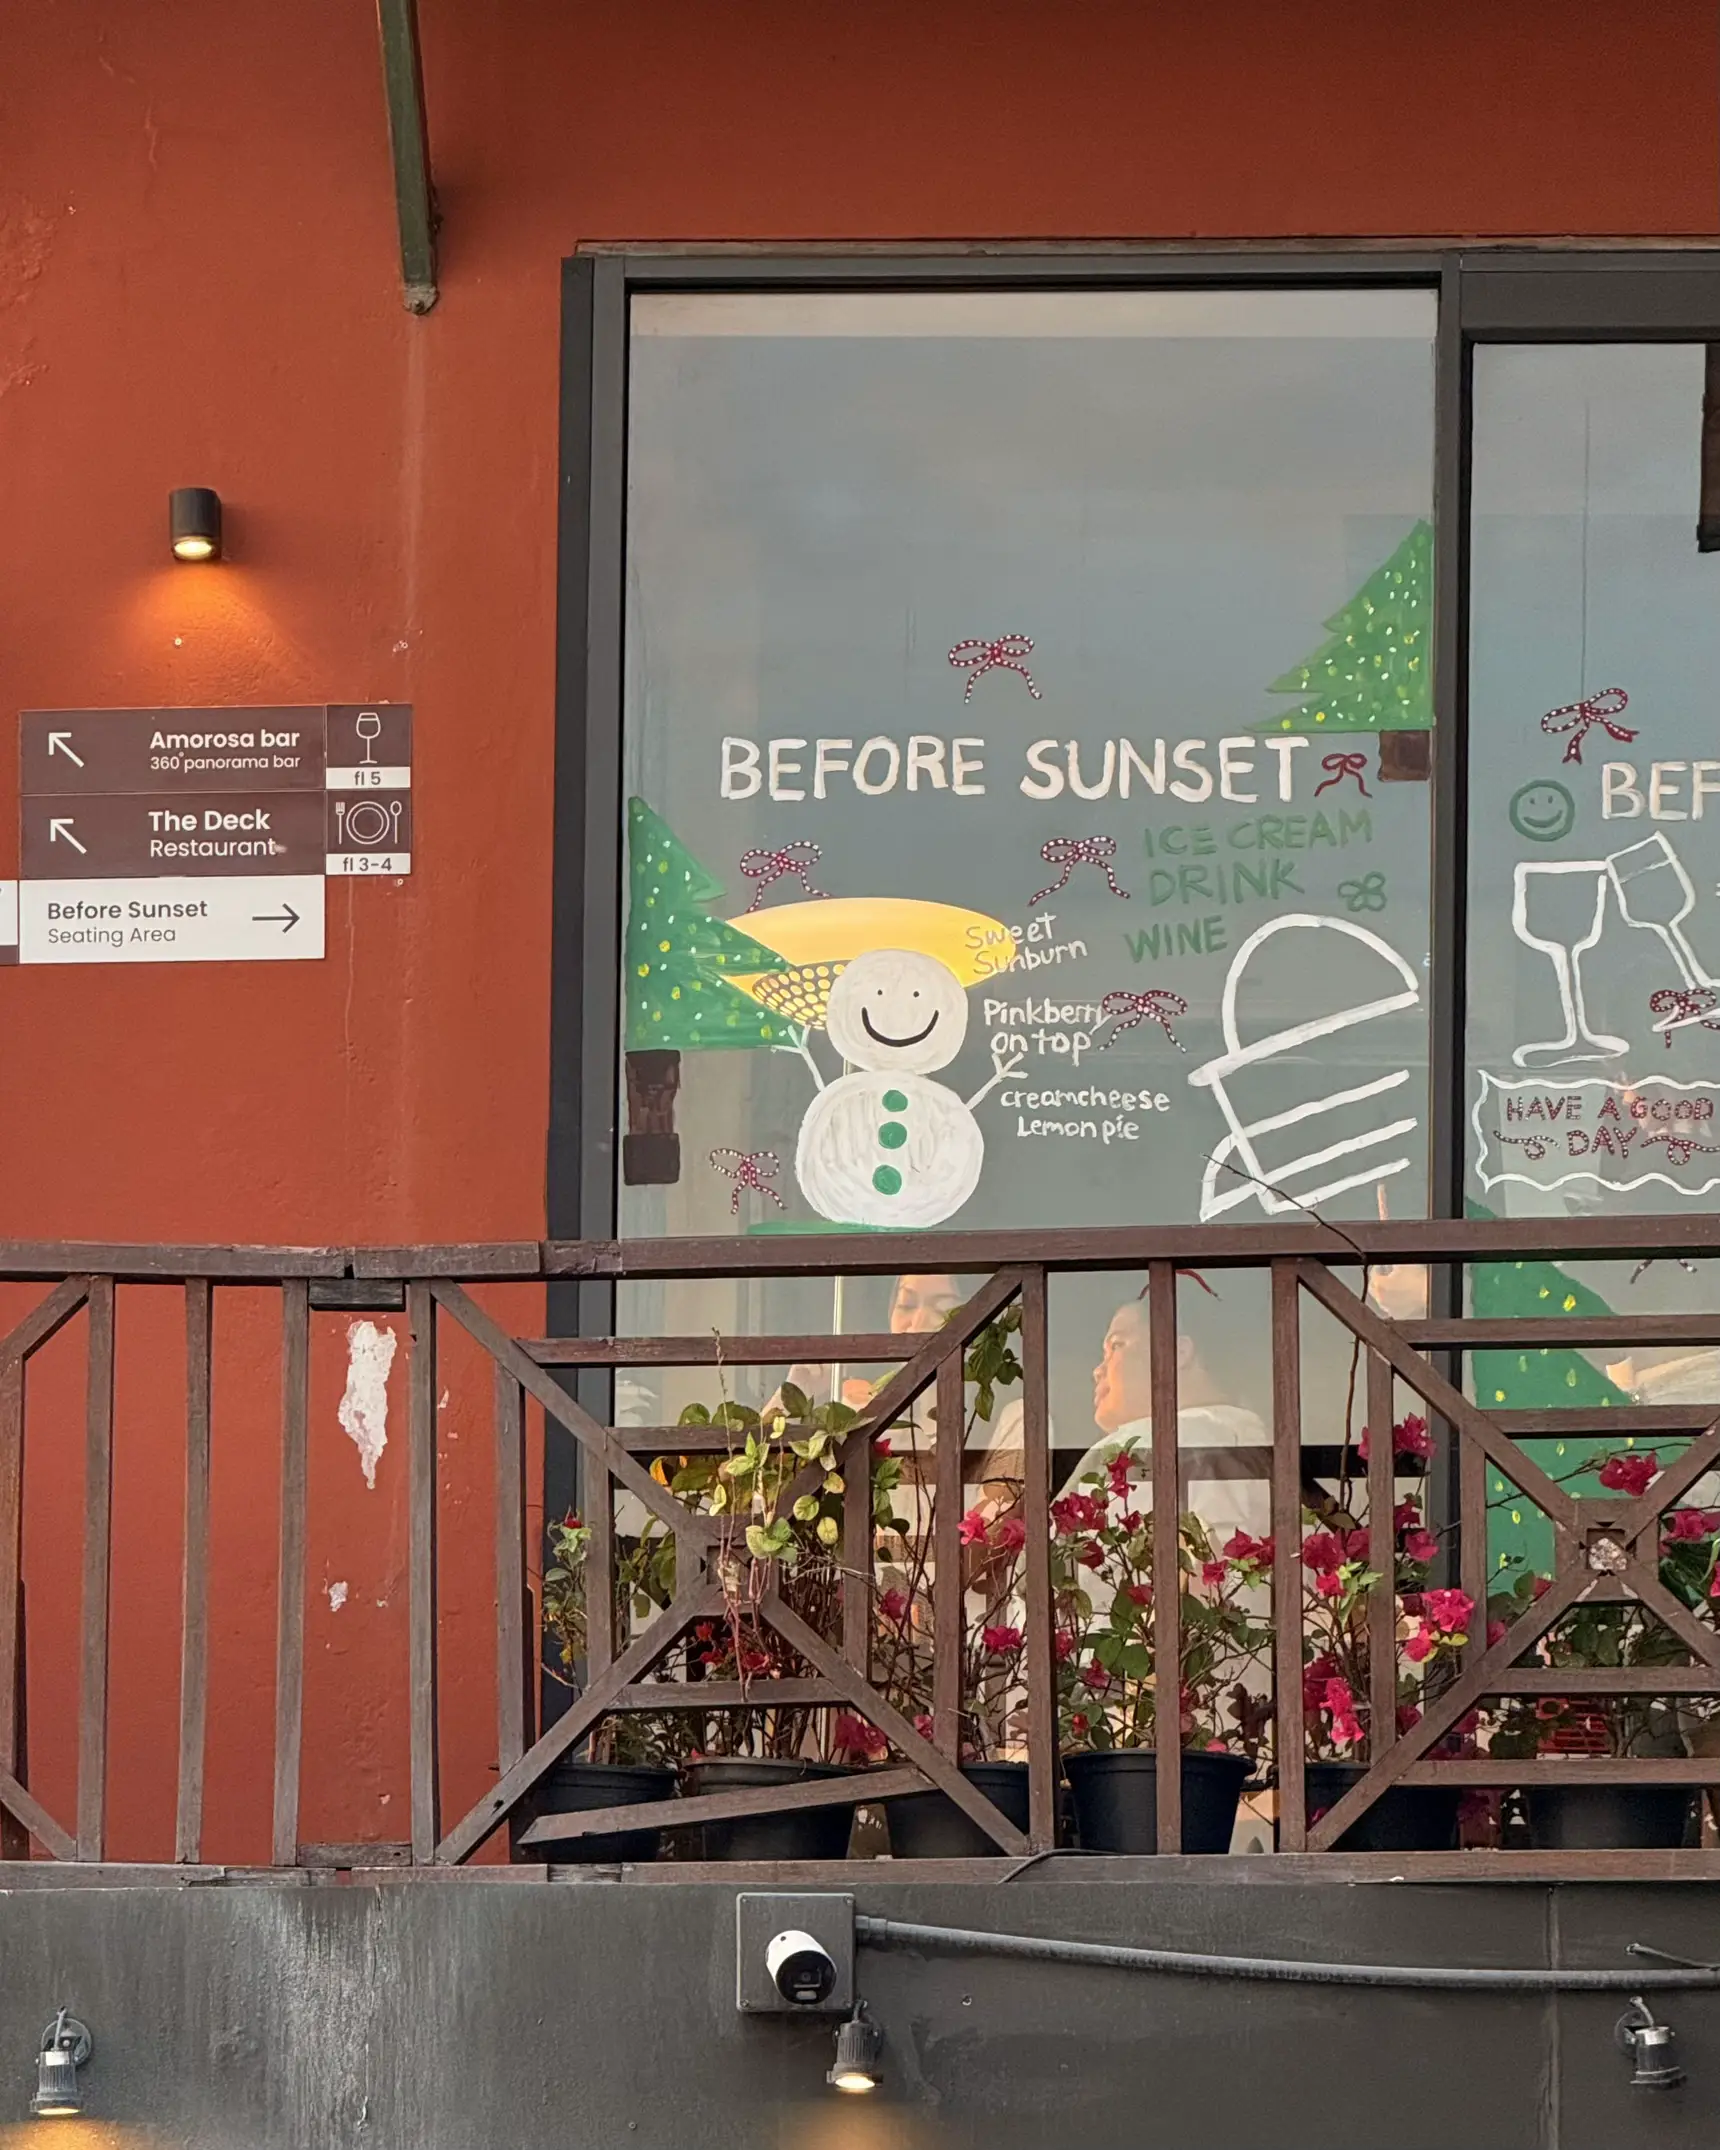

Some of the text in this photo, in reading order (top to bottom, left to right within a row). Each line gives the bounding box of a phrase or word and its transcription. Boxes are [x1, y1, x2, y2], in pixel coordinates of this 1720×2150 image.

[150, 729, 300, 749] Amorosa bar
[273, 754, 300, 768] bar
[720, 736, 1309, 802] BEFORE SUNSET
[354, 771, 381, 786] fl 5
[1602, 761, 1720, 821] BEF
[148, 808, 271, 832] The Deck
[1144, 808, 1373, 857] ICE CREAM
[150, 838, 277, 857] Restaurant
[343, 857, 392, 872] fl 3-4
[1149, 858, 1305, 906] DRINK
[48, 900, 208, 920] Before Sunset
[48, 926, 176, 947] Seating Area
[965, 912, 1057, 949] Sweet
[1123, 914, 1228, 964] WINE
[973, 940, 1088, 975] Sunburn
[1000, 1086, 1171, 1111] creamcheese
[1507, 1096, 1714, 1121] HAVE A GOOD
[1017, 1114, 1140, 1144] Lemon pie
[1567, 1125, 1638, 1159] DAY
